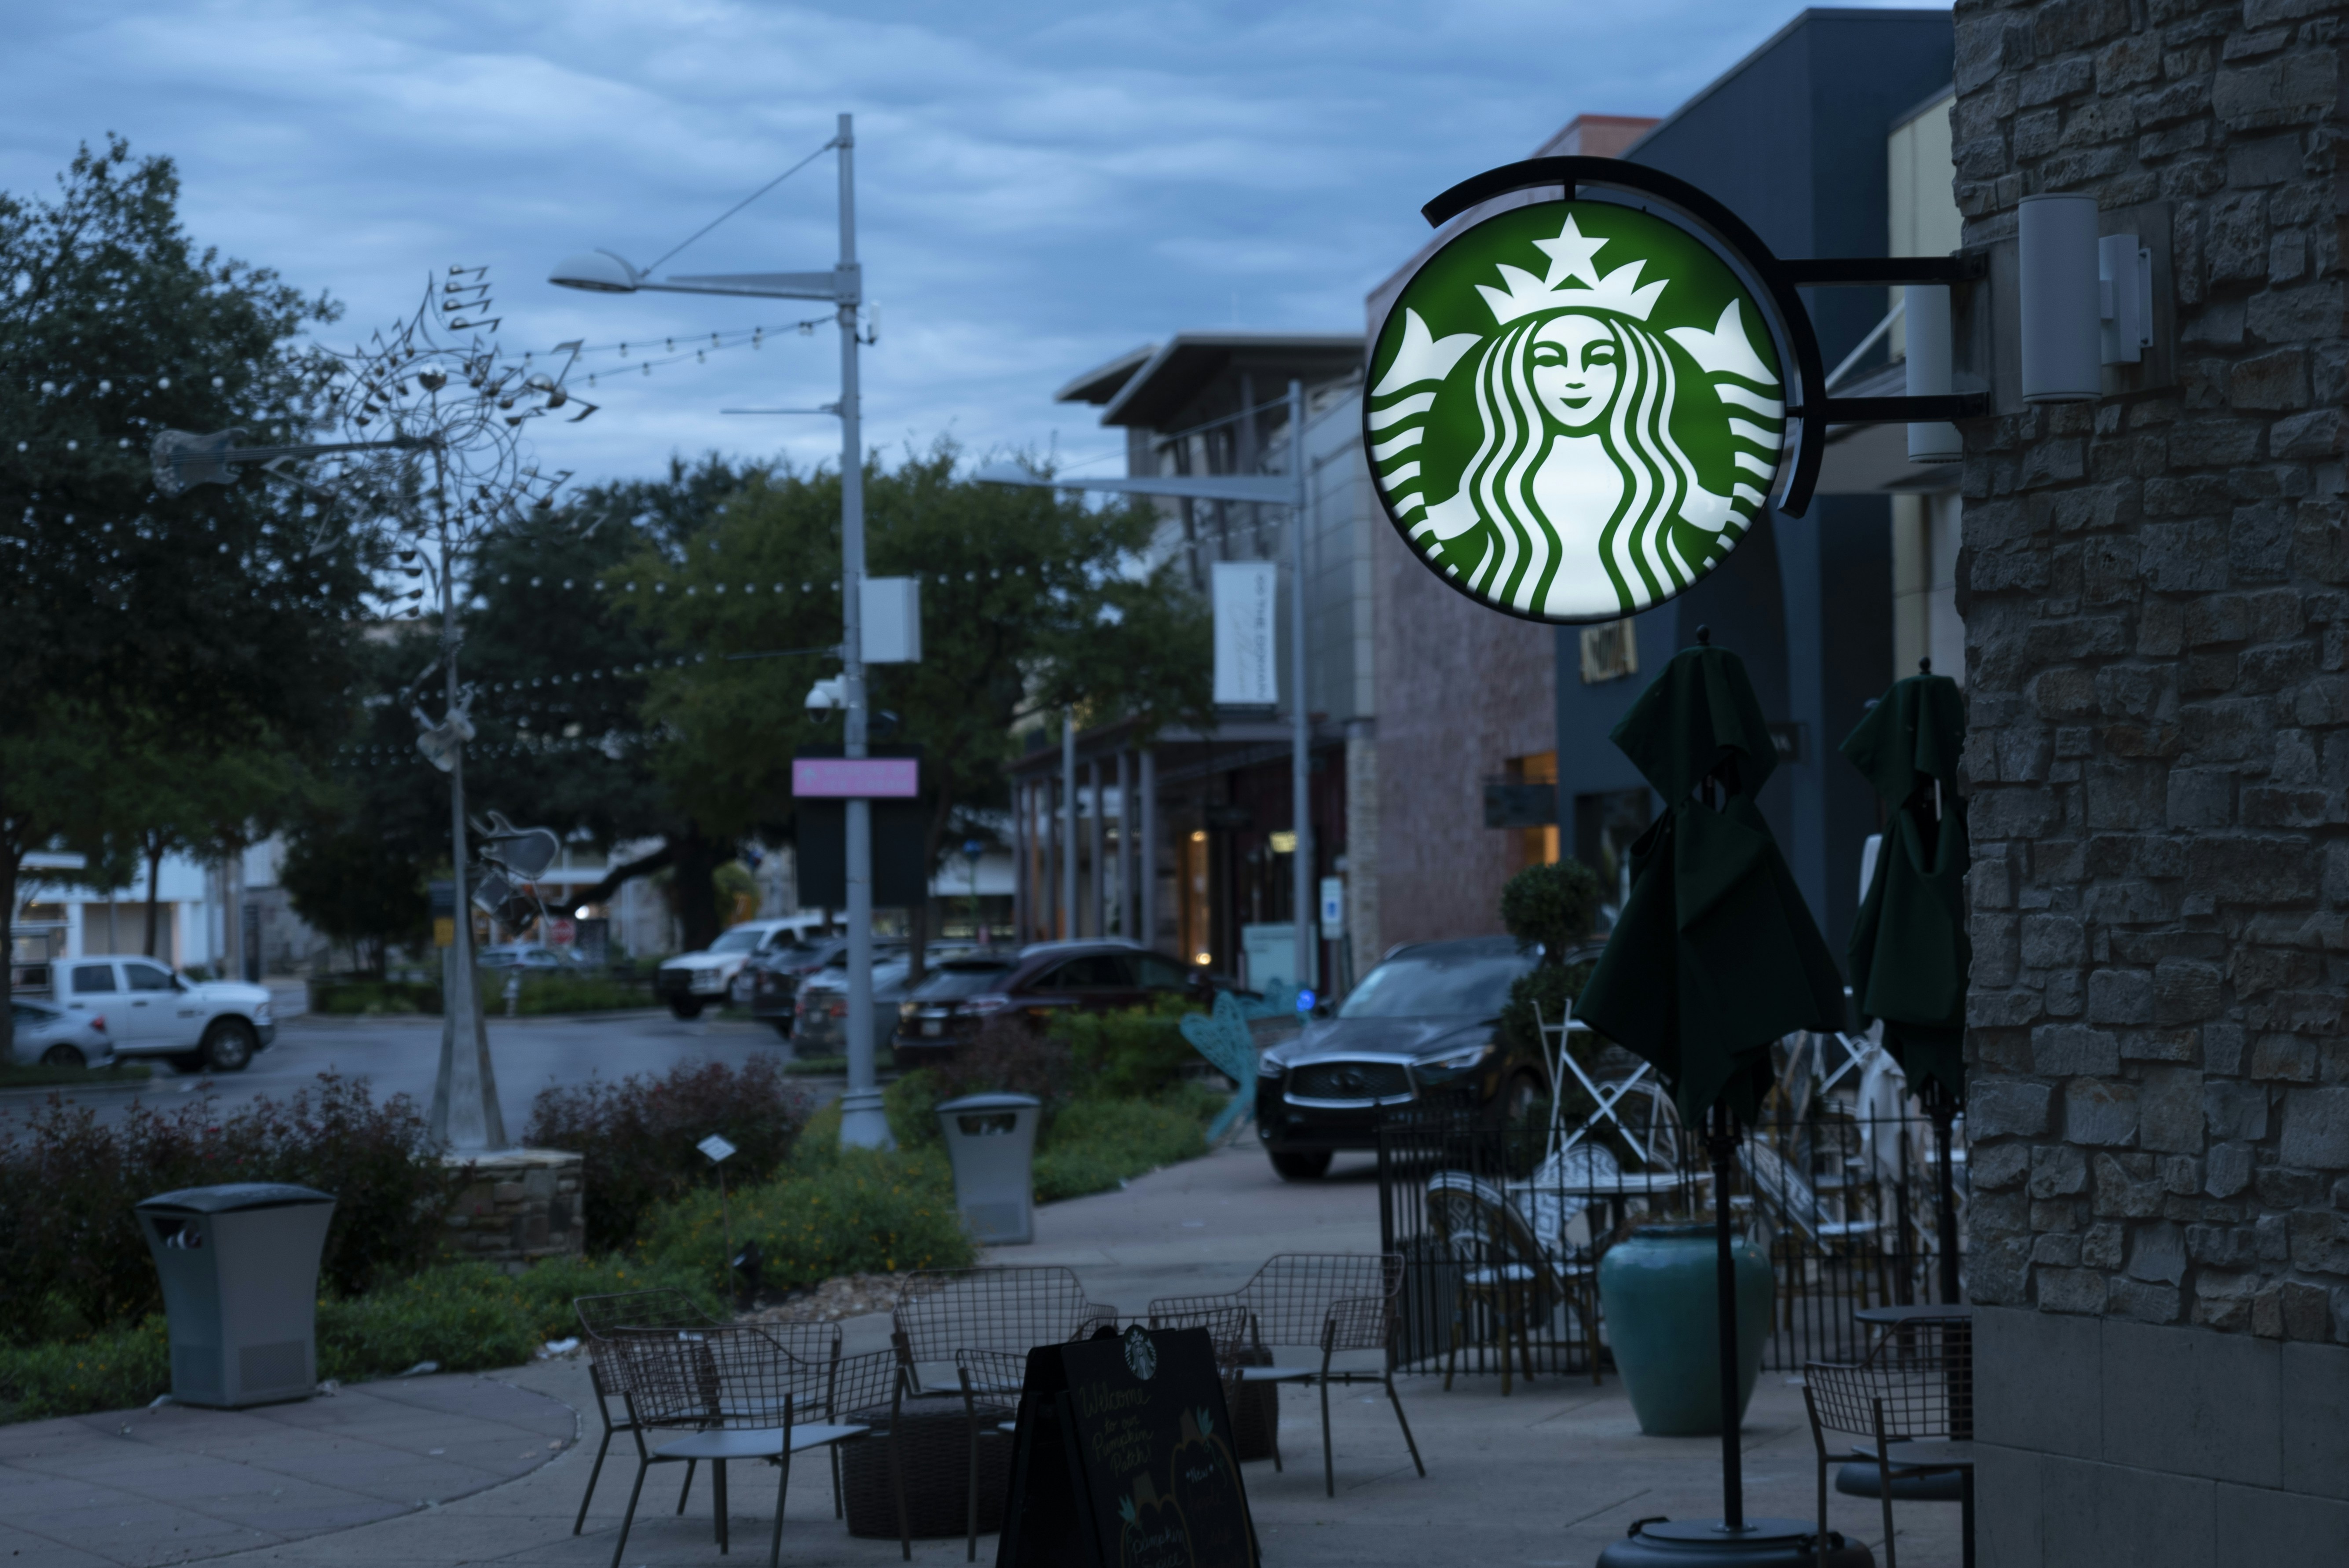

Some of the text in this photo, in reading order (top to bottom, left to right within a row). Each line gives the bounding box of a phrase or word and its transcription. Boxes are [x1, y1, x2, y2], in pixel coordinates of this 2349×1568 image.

[1079, 1381, 1151, 1418] Welcome
[1104, 1414, 1140, 1436] to our
[1092, 1429, 1154, 1463] Pumpkin
[1110, 1443, 1151, 1478] Patch!
